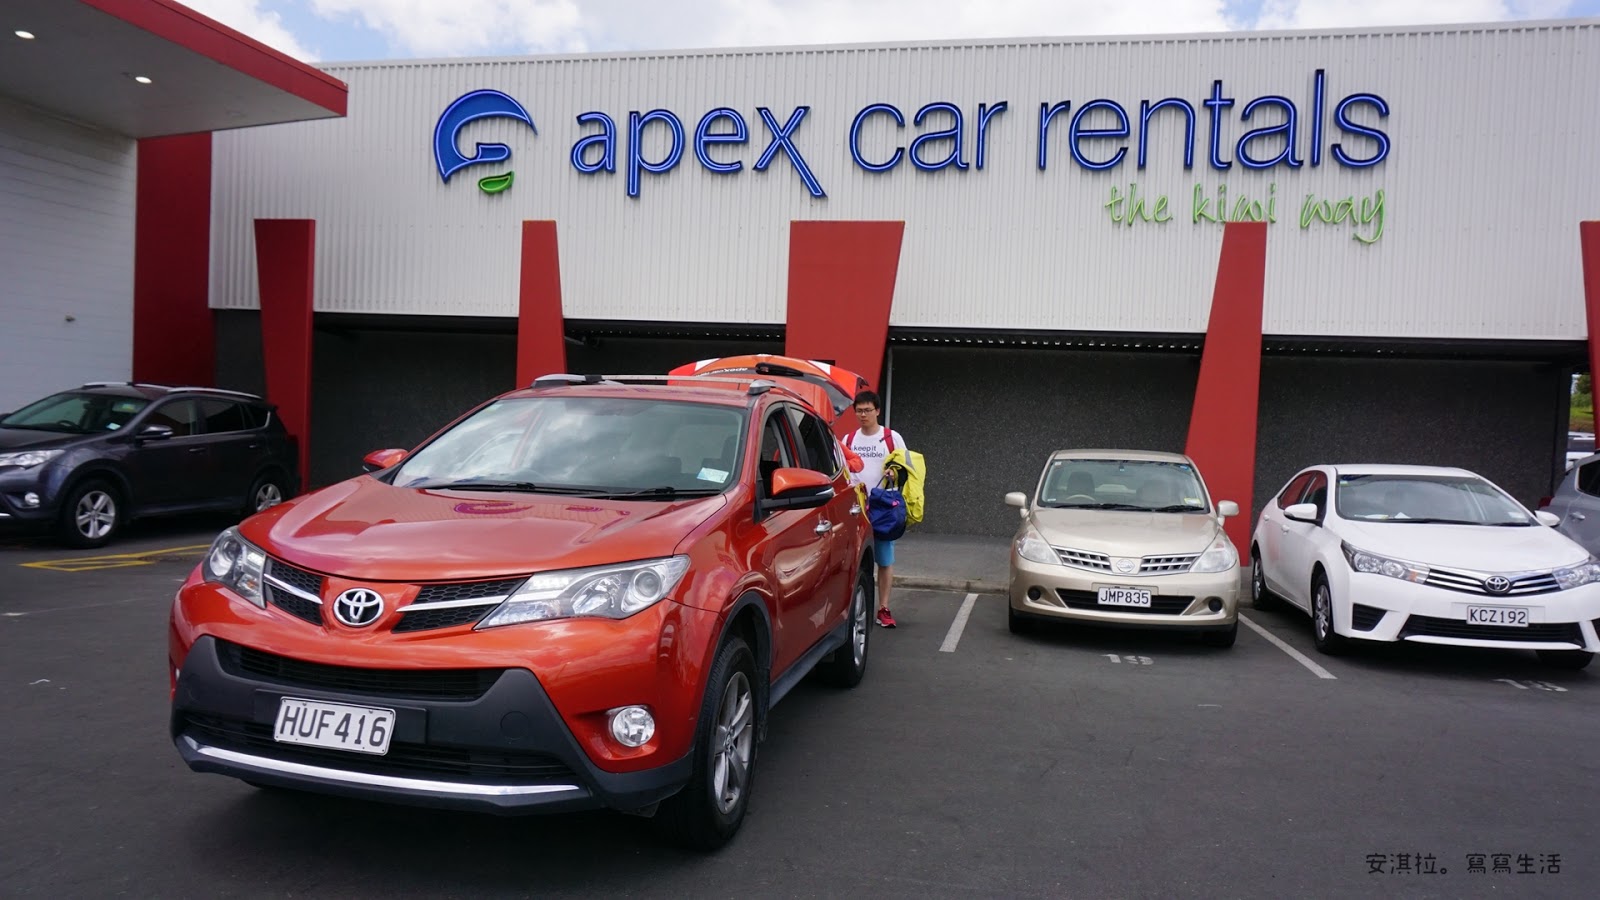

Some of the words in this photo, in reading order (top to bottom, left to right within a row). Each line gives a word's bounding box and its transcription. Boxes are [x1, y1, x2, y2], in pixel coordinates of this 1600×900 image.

[570, 105, 827, 198] apex
[849, 100, 1008, 172] car
[1038, 68, 1391, 172] rentals
[1105, 183, 1173, 226] the
[1192, 183, 1277, 223] kiwi
[1300, 189, 1385, 244] way
[1100, 590, 1149, 605] JMP835
[1469, 608, 1526, 624] KCZ192
[279, 705, 388, 747] HUF416
